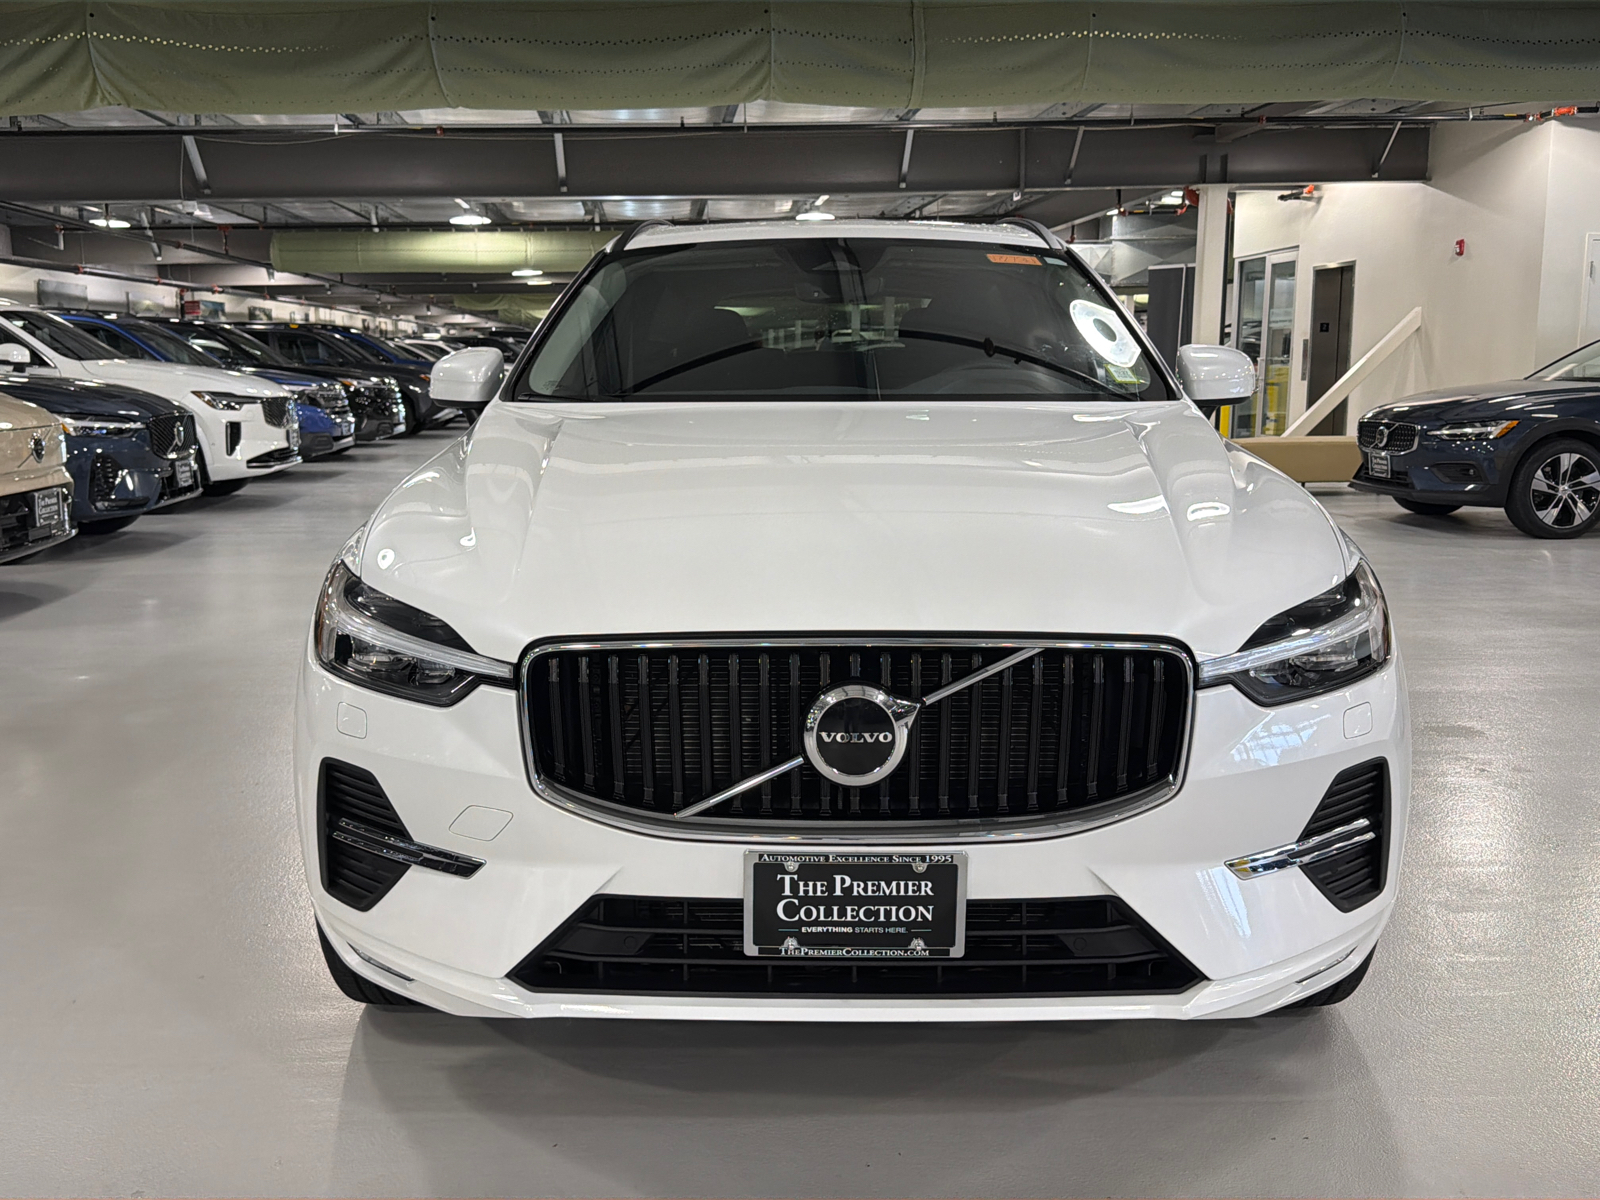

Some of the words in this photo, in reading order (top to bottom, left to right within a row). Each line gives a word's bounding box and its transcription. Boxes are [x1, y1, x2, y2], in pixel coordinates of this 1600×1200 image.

[819, 731, 893, 743] VOLVO
[761, 854, 826, 862] AUTOMOTIVE
[828, 854, 890, 863] EXCELLENCE
[892, 854, 921, 863] SINCE
[925, 855, 952, 863] 1995
[776, 874, 828, 896] THE
[832, 874, 935, 897] PREMIER
[776, 898, 935, 922] COLLECTION
[854, 926, 884, 934] STARTS
[885, 926, 909, 934] HERE.
